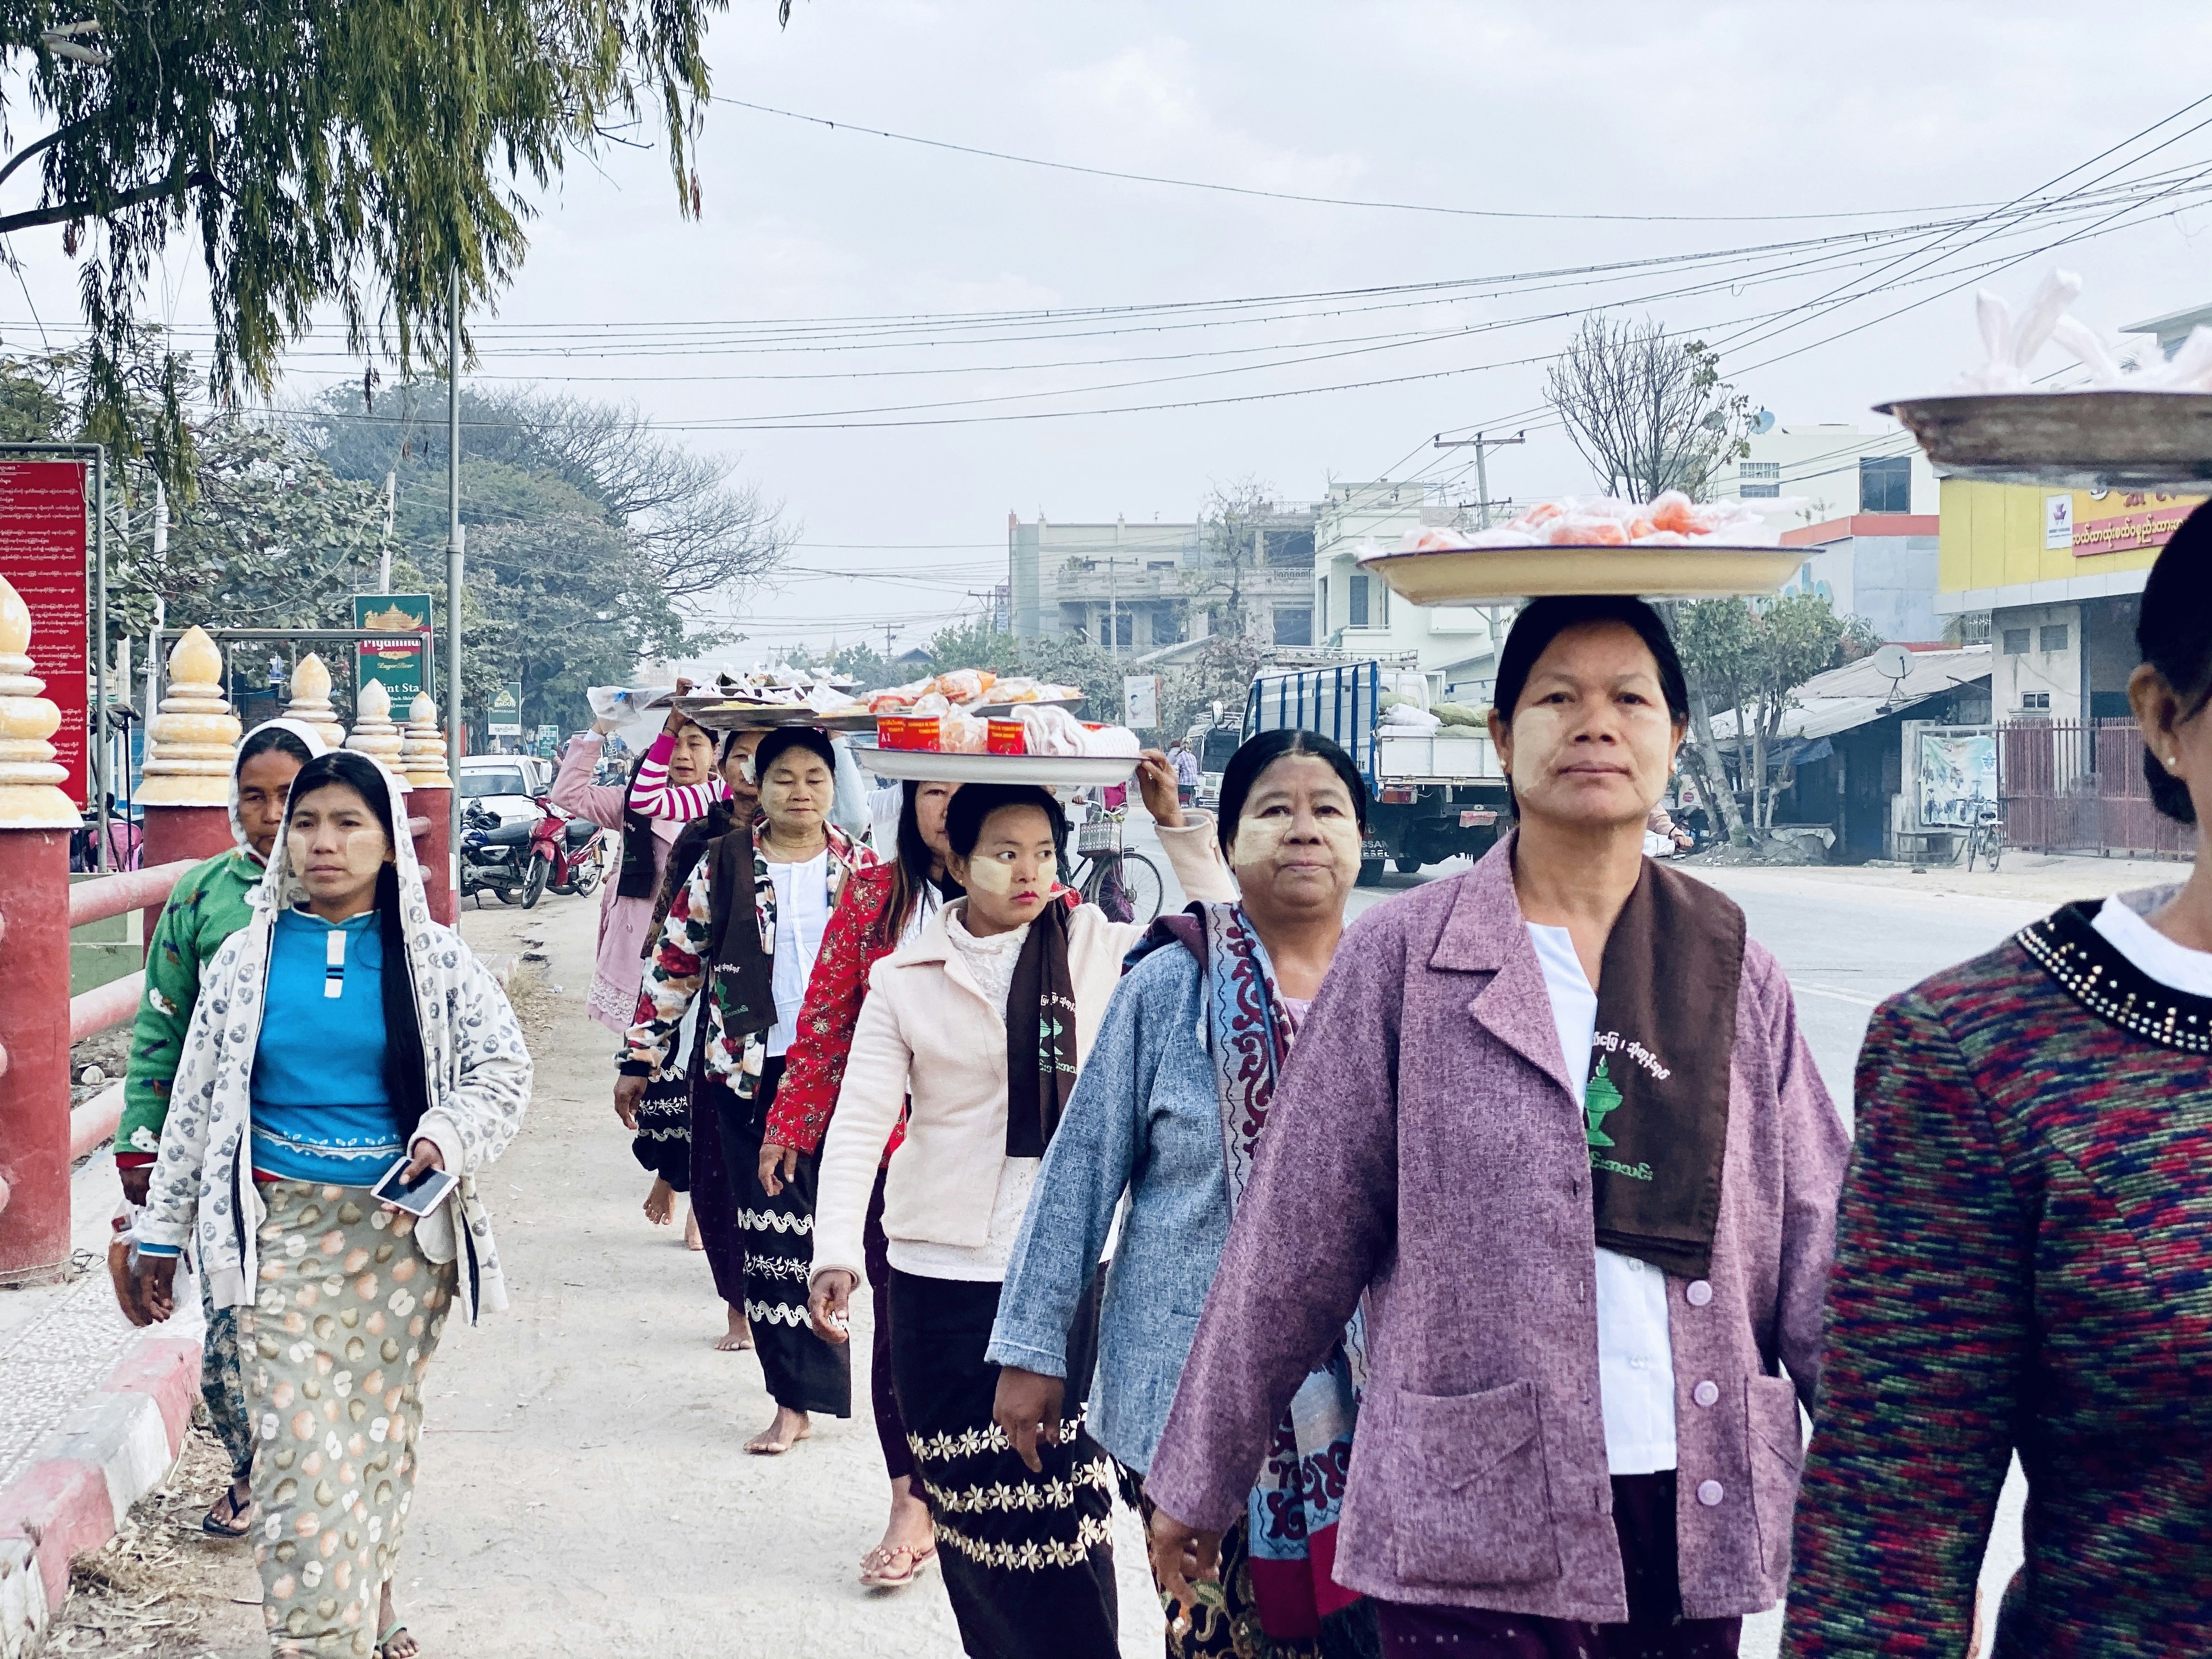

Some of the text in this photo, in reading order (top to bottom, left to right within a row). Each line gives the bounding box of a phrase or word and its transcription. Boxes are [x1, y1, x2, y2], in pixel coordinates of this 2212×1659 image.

[383, 683, 420, 693] int Sta
[880, 732, 891, 742] A1
[1361, 840, 1388, 848] SSAN
